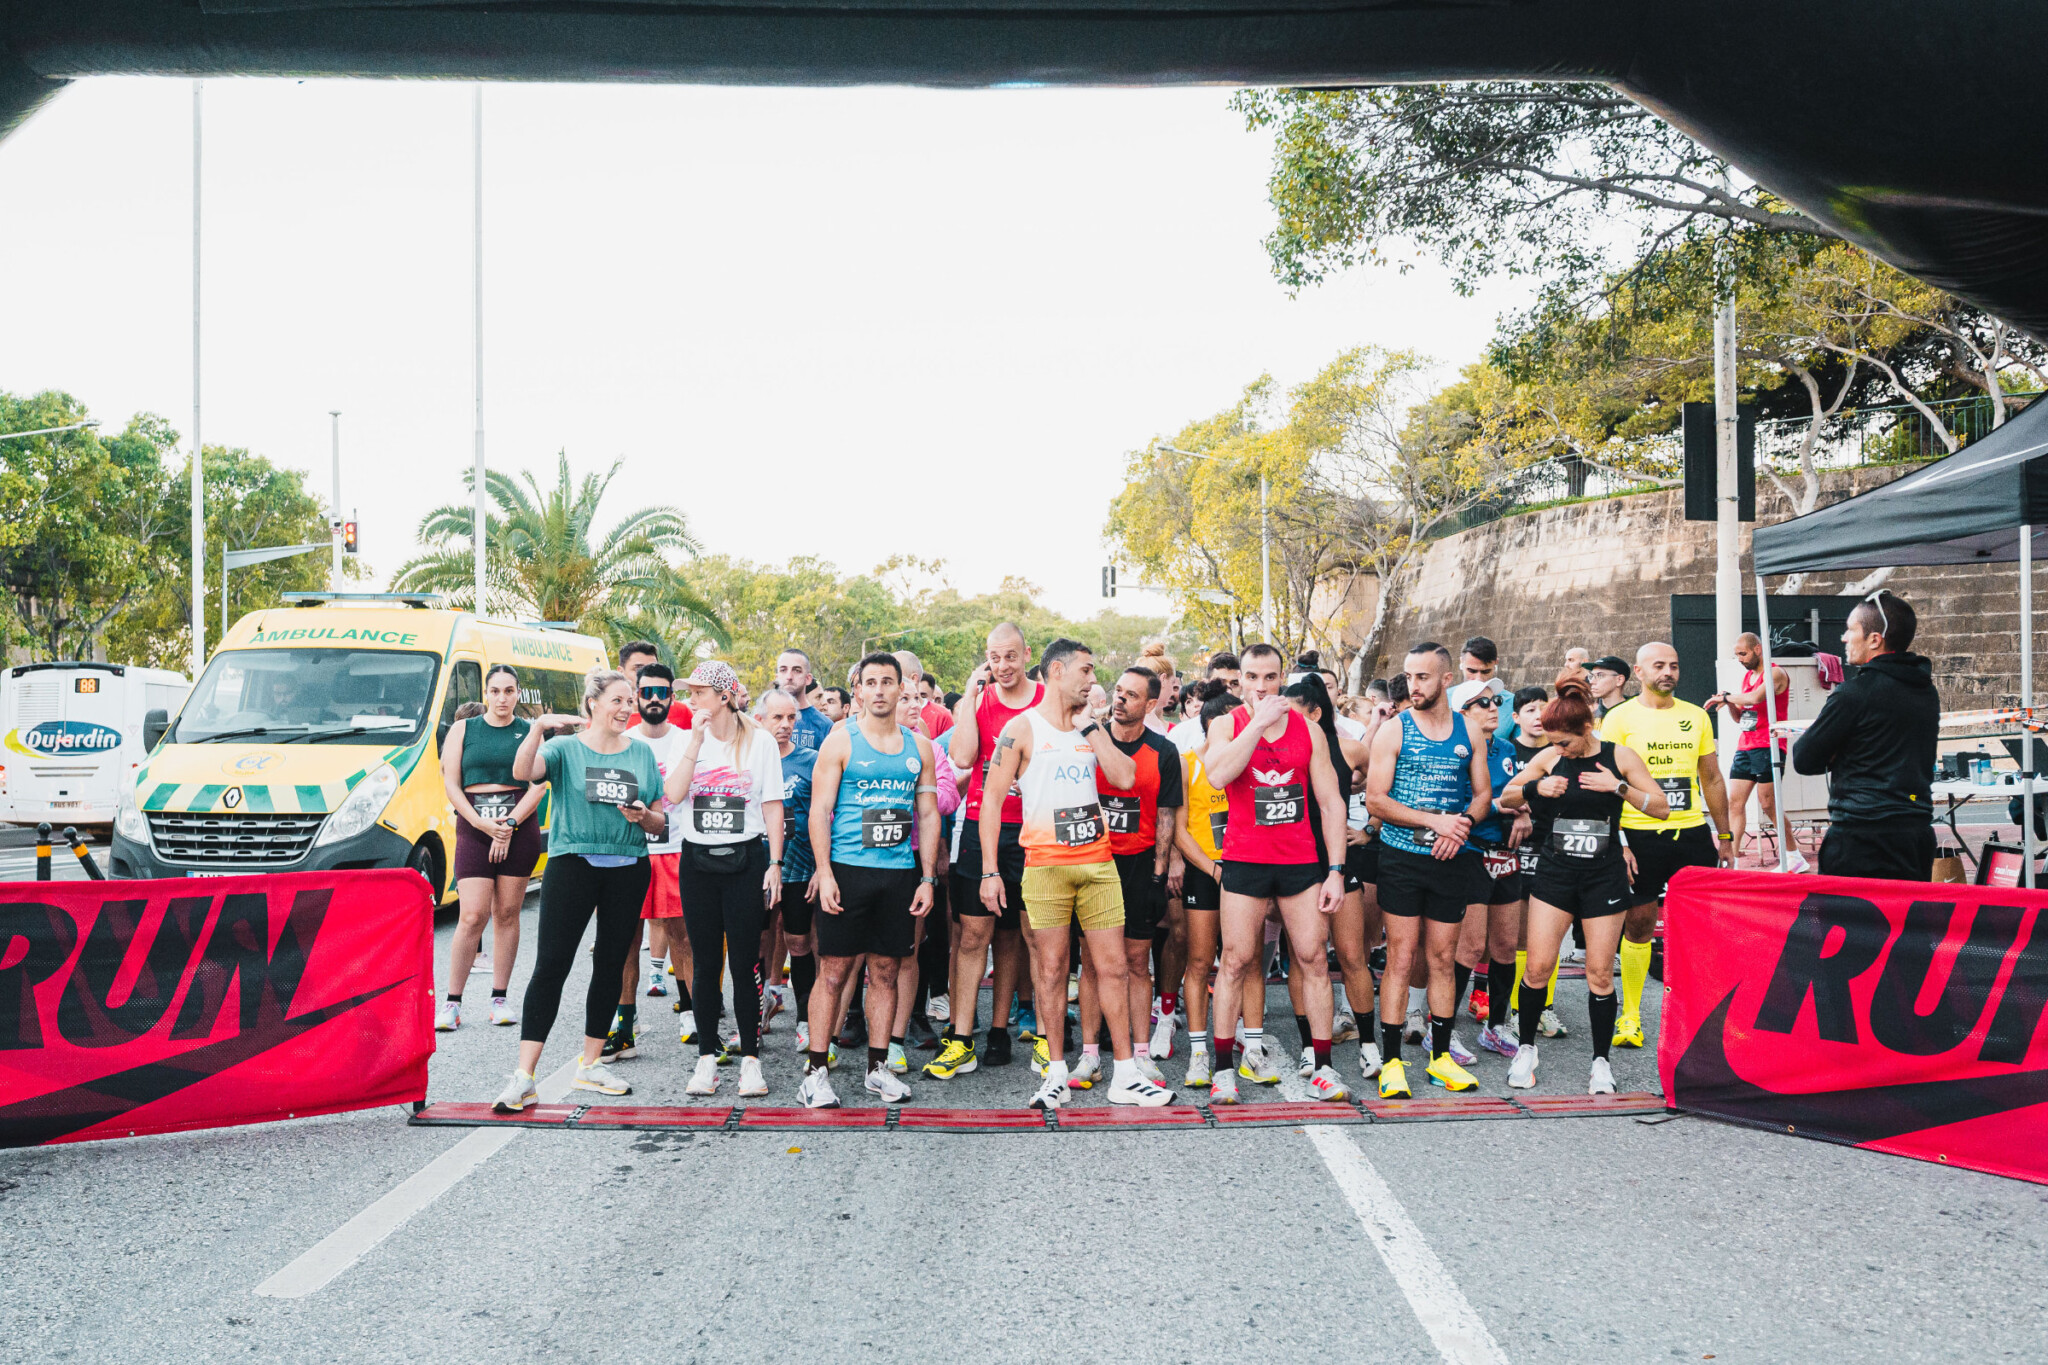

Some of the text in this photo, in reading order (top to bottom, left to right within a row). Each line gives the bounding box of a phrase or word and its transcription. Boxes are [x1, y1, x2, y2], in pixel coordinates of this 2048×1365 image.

[249, 628, 418, 646] AMBULANCE
[511, 637, 573, 662] AMBULANCE
[80, 678, 96, 693] 88
[27, 728, 117, 753] Dujardin
[1647, 741, 1694, 751] Mariano
[1648, 755, 1674, 765] Club
[1054, 764, 1092, 784] AQA
[1420, 774, 1458, 782] GARMIN
[596, 781, 628, 800] 893
[699, 785, 741, 794] VALLETTA
[857, 779, 916, 791] GARMIN
[1210, 794, 1228, 803] CYP
[1667, 792, 1686, 806] 02
[480, 806, 508, 818] 812
[1265, 801, 1297, 820] 229
[701, 811, 734, 828] 892
[872, 824, 903, 842] 875
[1066, 821, 1097, 841] 193
[1563, 834, 1598, 853] 270
[1520, 855, 1539, 870] 54
